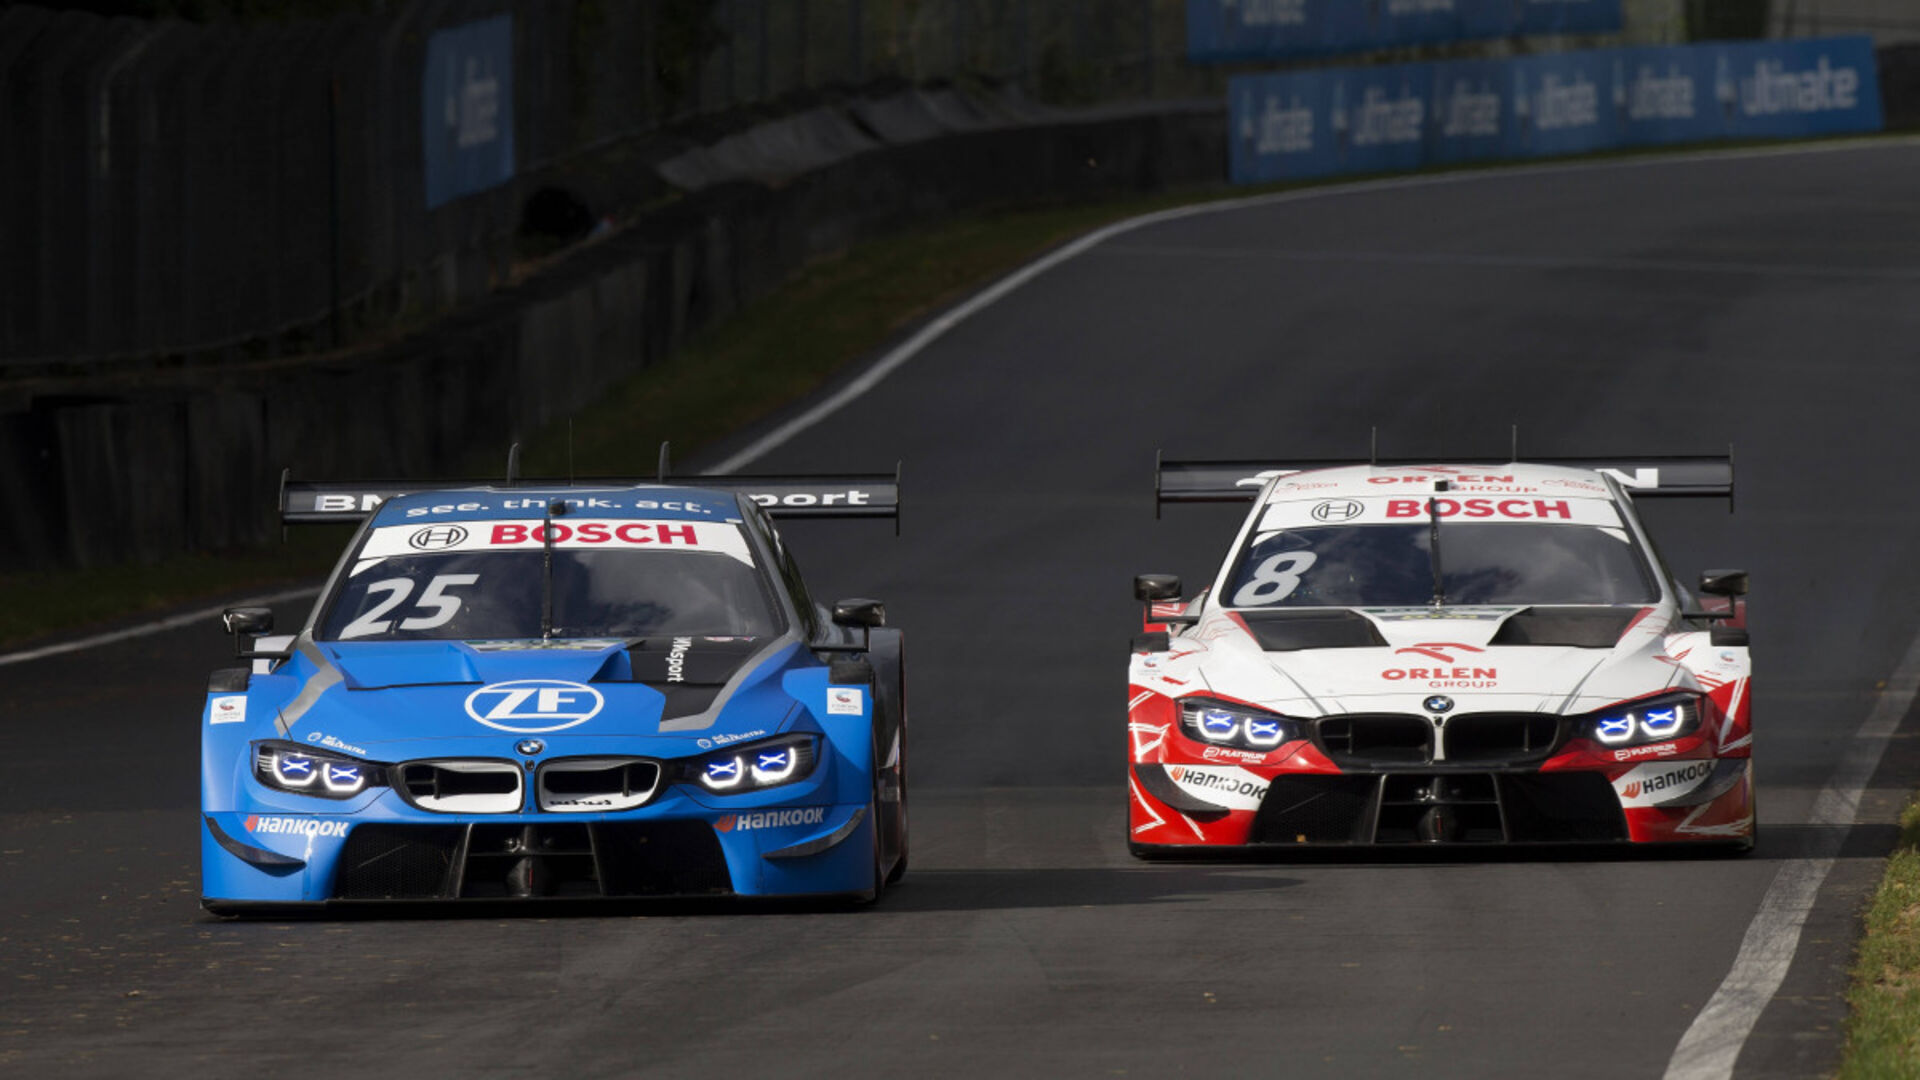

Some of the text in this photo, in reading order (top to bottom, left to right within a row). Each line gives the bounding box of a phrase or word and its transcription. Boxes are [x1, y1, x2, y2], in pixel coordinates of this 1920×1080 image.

[406, 497, 712, 518] see. thnk. act.
[1386, 499, 1572, 519] BOSCH
[490, 523, 698, 545] BOSCH
[1233, 550, 1317, 606] 8
[338, 573, 481, 640] 25
[1382, 668, 1497, 680] ORLEN
[476, 687, 592, 719] ZF
